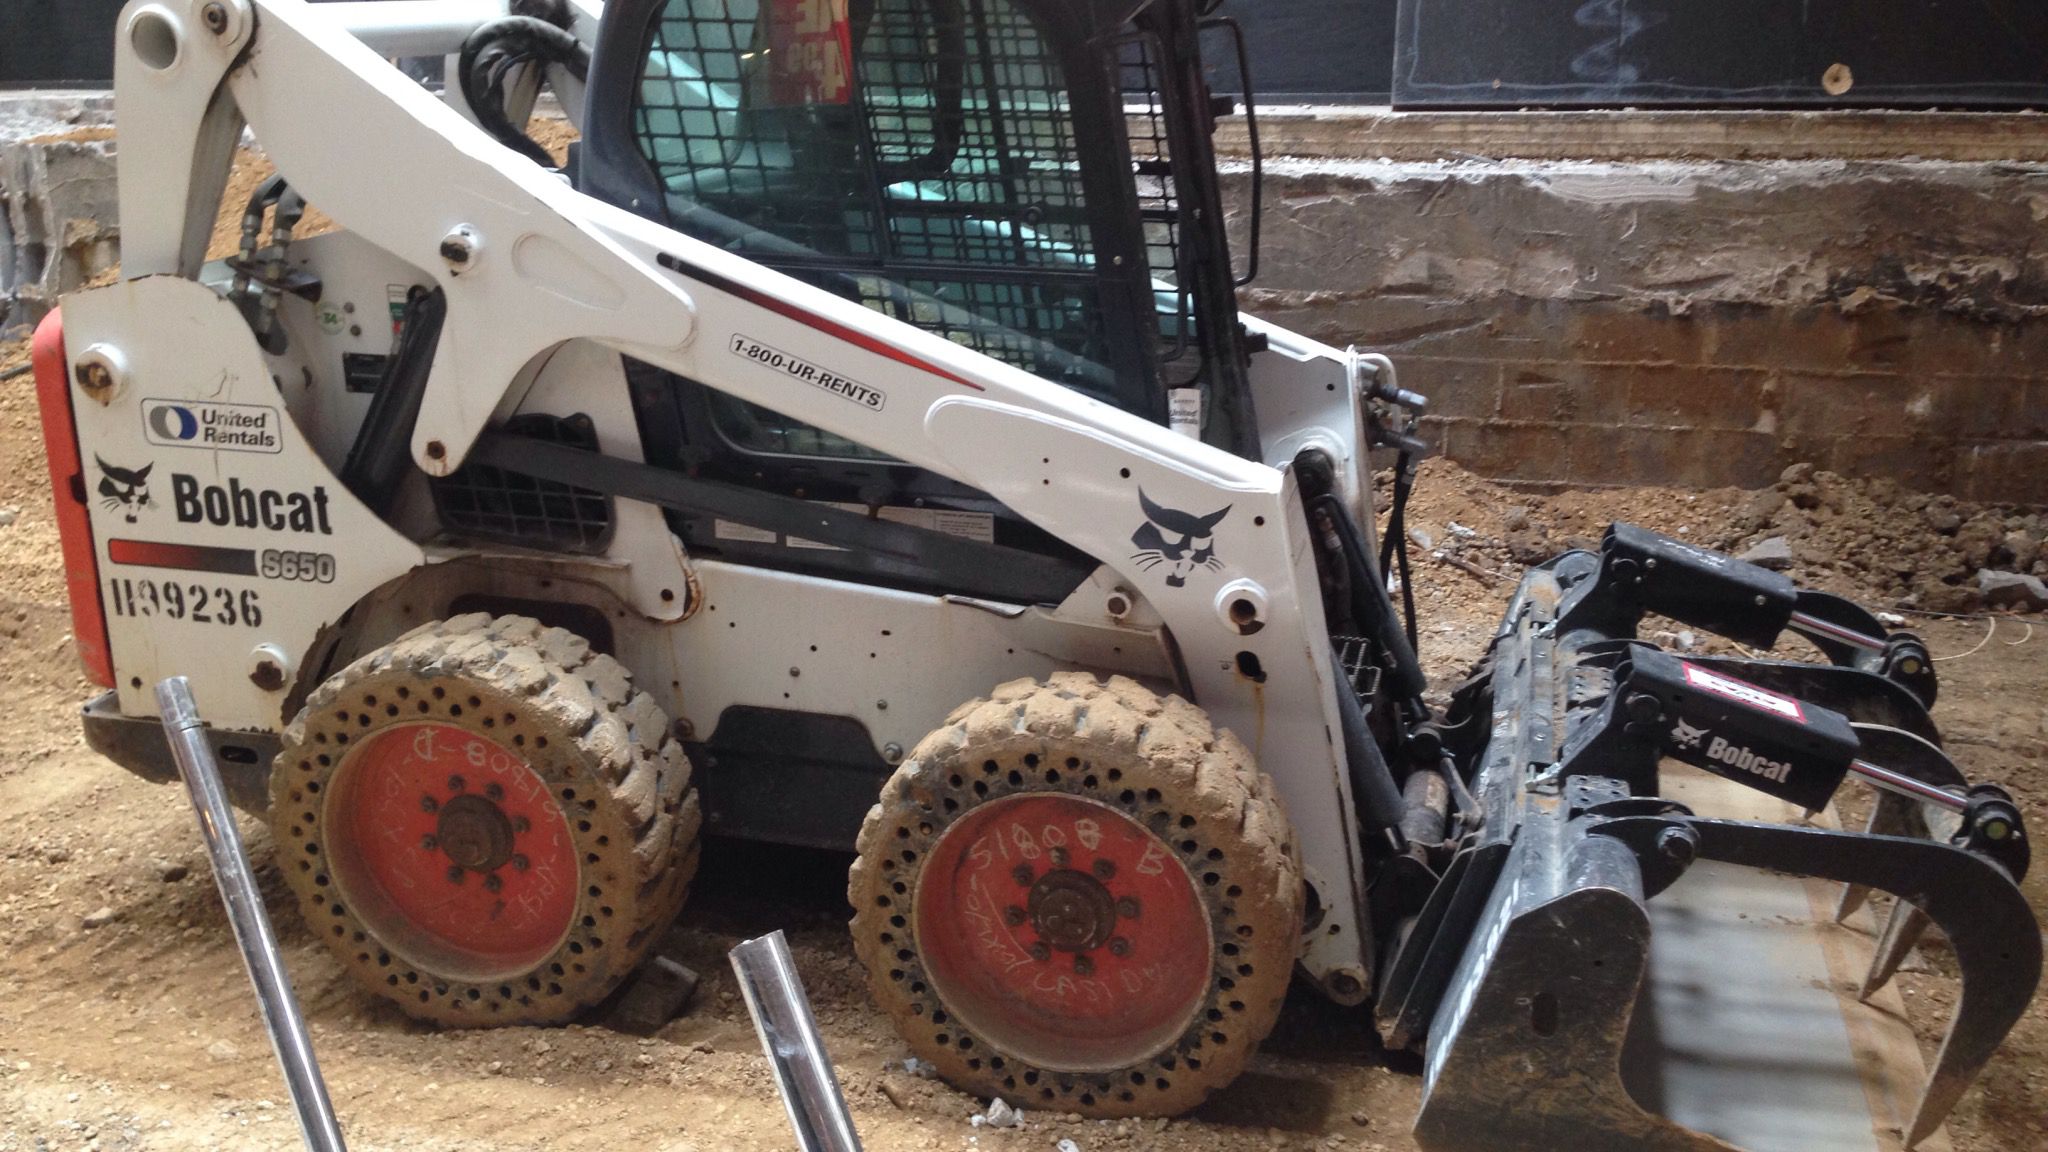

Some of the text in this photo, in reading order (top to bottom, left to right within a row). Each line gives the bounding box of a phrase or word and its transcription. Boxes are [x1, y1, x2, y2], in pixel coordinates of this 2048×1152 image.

[733, 338, 882, 407] 1-800-UR-RENTS
[202, 409, 266, 429] United
[203, 425, 275, 447] Rentals
[171, 473, 333, 535] Bobcat
[261, 549, 336, 583] S650
[1706, 735, 1792, 784] Bobcat
